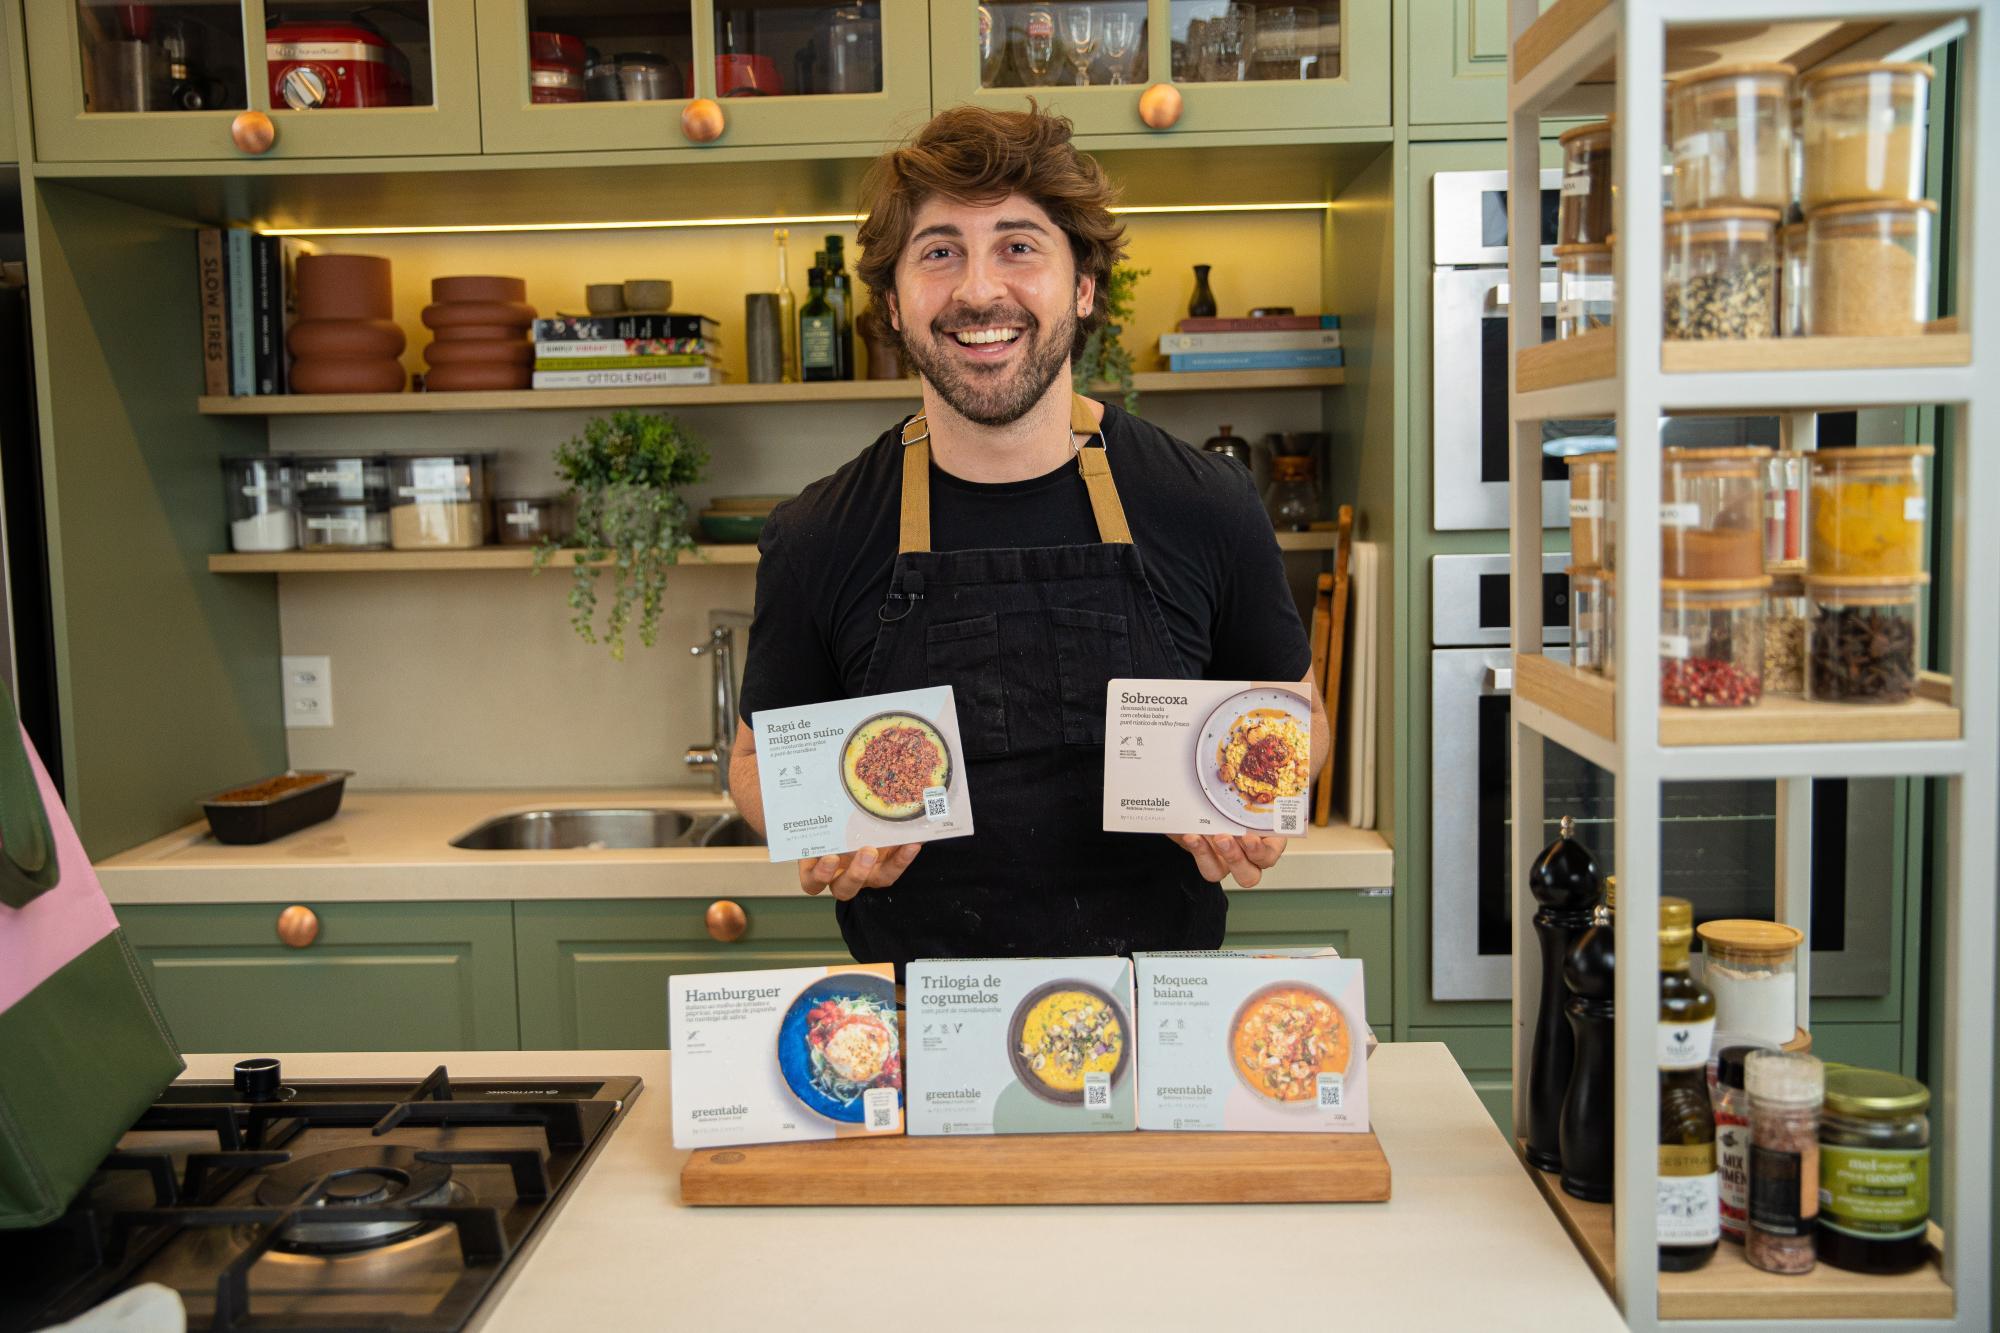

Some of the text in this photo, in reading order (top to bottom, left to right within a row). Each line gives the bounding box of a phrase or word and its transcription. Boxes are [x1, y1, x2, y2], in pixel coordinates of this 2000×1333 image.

[204, 257, 222, 362] SLOW FIRES
[586, 370, 667, 385] OTTOLENGHI
[1121, 692, 1188, 705] Sobrecoxa
[767, 719, 811, 734] Ragú de
[769, 727, 844, 745] mignon suíno
[1120, 798, 1170, 807] greentable
[783, 814, 833, 831] greentable
[920, 974, 1001, 991] Trilogia de
[1153, 974, 1208, 987] Moqueca
[685, 987, 781, 1002] Hamburguer
[921, 990, 999, 1007] cogumelos
[1153, 987, 1194, 998] baiana
[926, 1088, 982, 1101] greentable
[1156, 1084, 1213, 1097] greentable
[691, 1104, 748, 1119] greentable
[1723, 1152, 1743, 1170] MIX
[1716, 1164, 1748, 1185] IMEN
